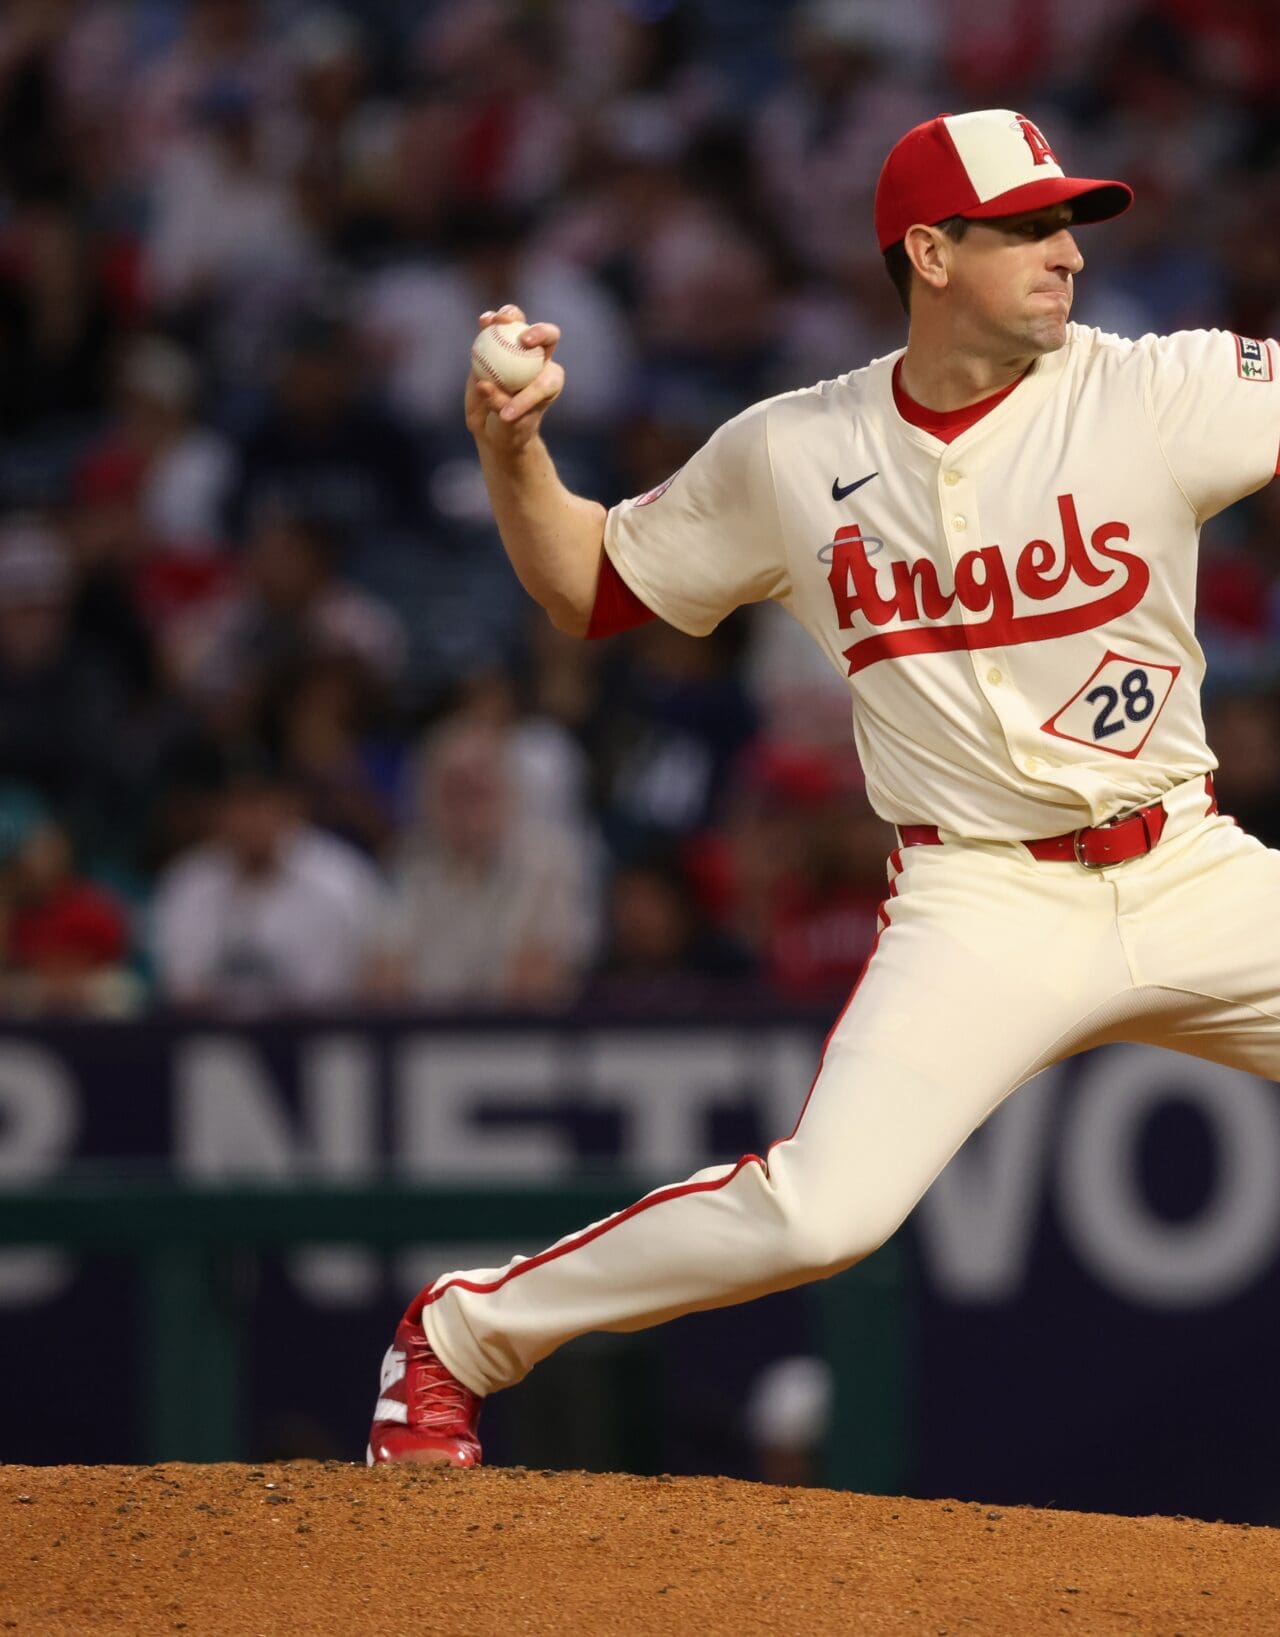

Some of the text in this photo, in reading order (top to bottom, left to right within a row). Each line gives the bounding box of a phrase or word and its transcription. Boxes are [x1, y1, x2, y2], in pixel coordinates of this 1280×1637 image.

[1015, 113, 1060, 166] A
[827, 493, 1151, 677] Angels
[1084, 668, 1155, 741] 28
